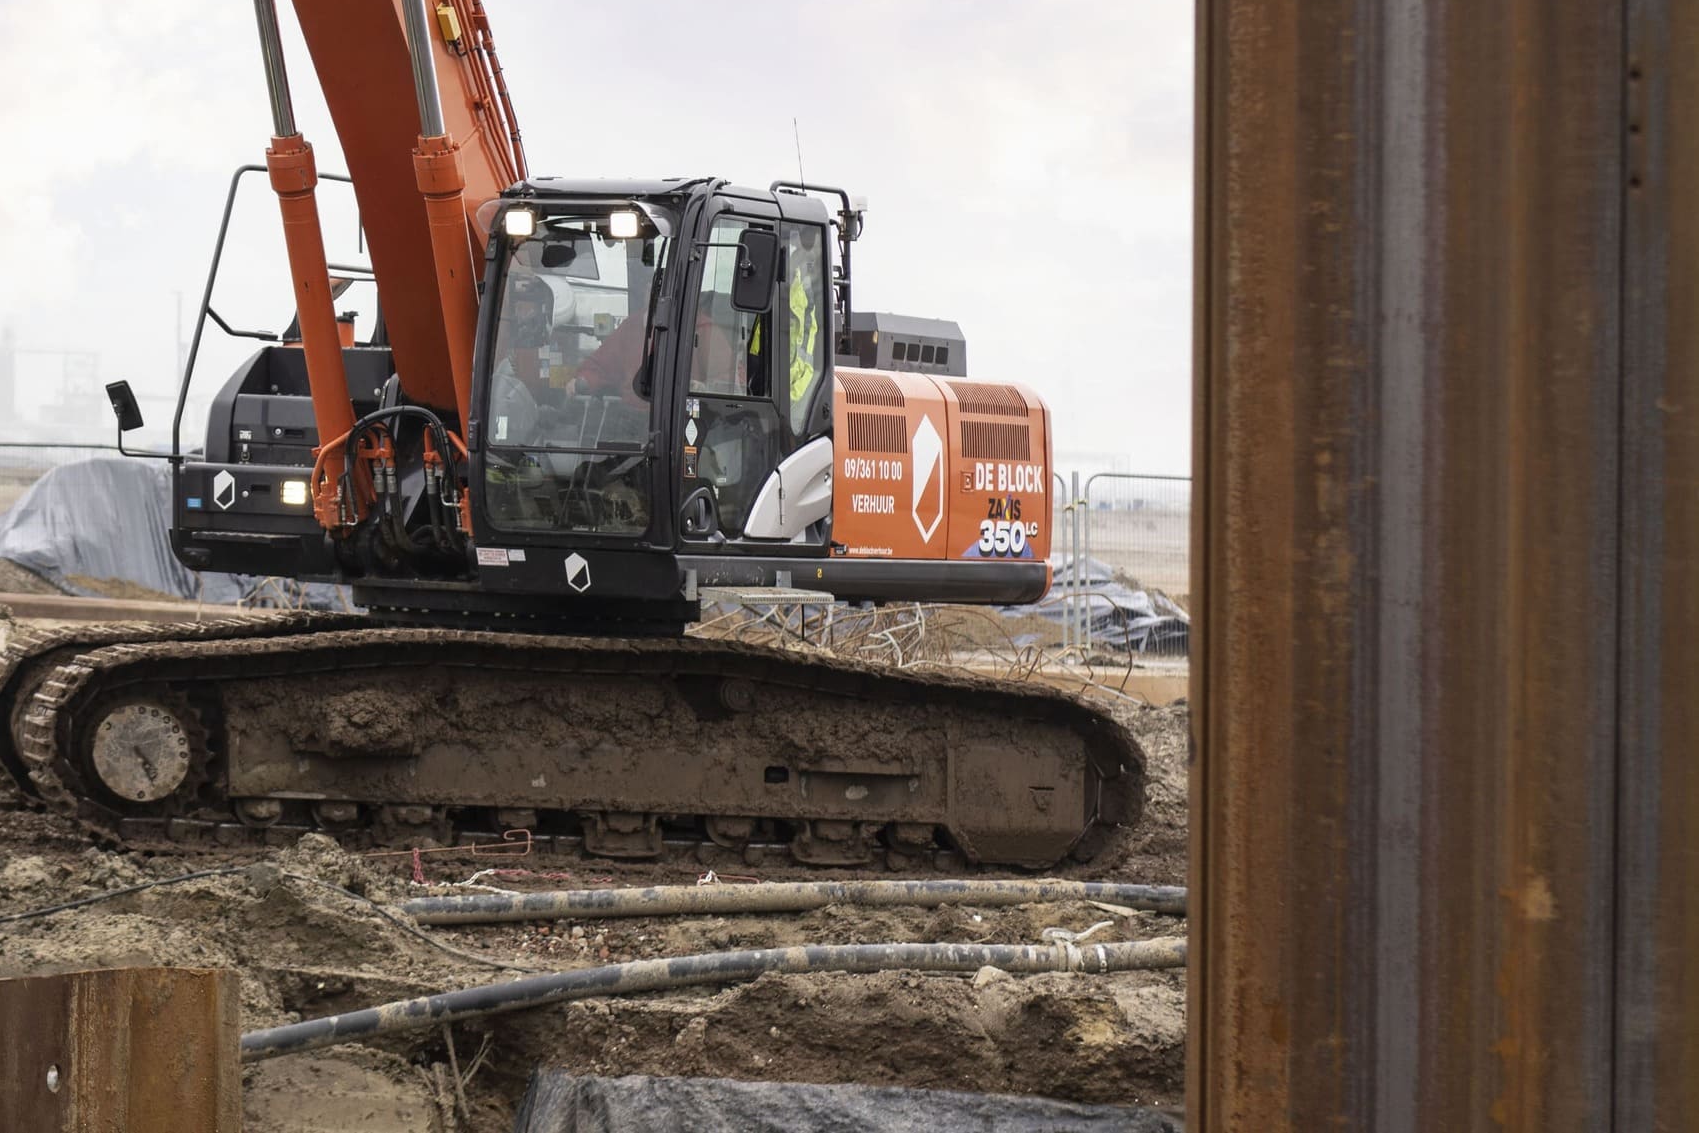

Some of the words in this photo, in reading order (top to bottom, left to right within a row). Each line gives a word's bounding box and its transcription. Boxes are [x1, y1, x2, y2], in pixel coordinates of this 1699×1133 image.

[844, 457, 876, 480] 09/361
[878, 460, 890, 480] 10
[891, 461, 903, 481] 00
[975, 462, 994, 491] DE
[997, 463, 1044, 493] BLOCK
[852, 494, 895, 515] VERHUUR
[988, 494, 1021, 521] ZAXIS
